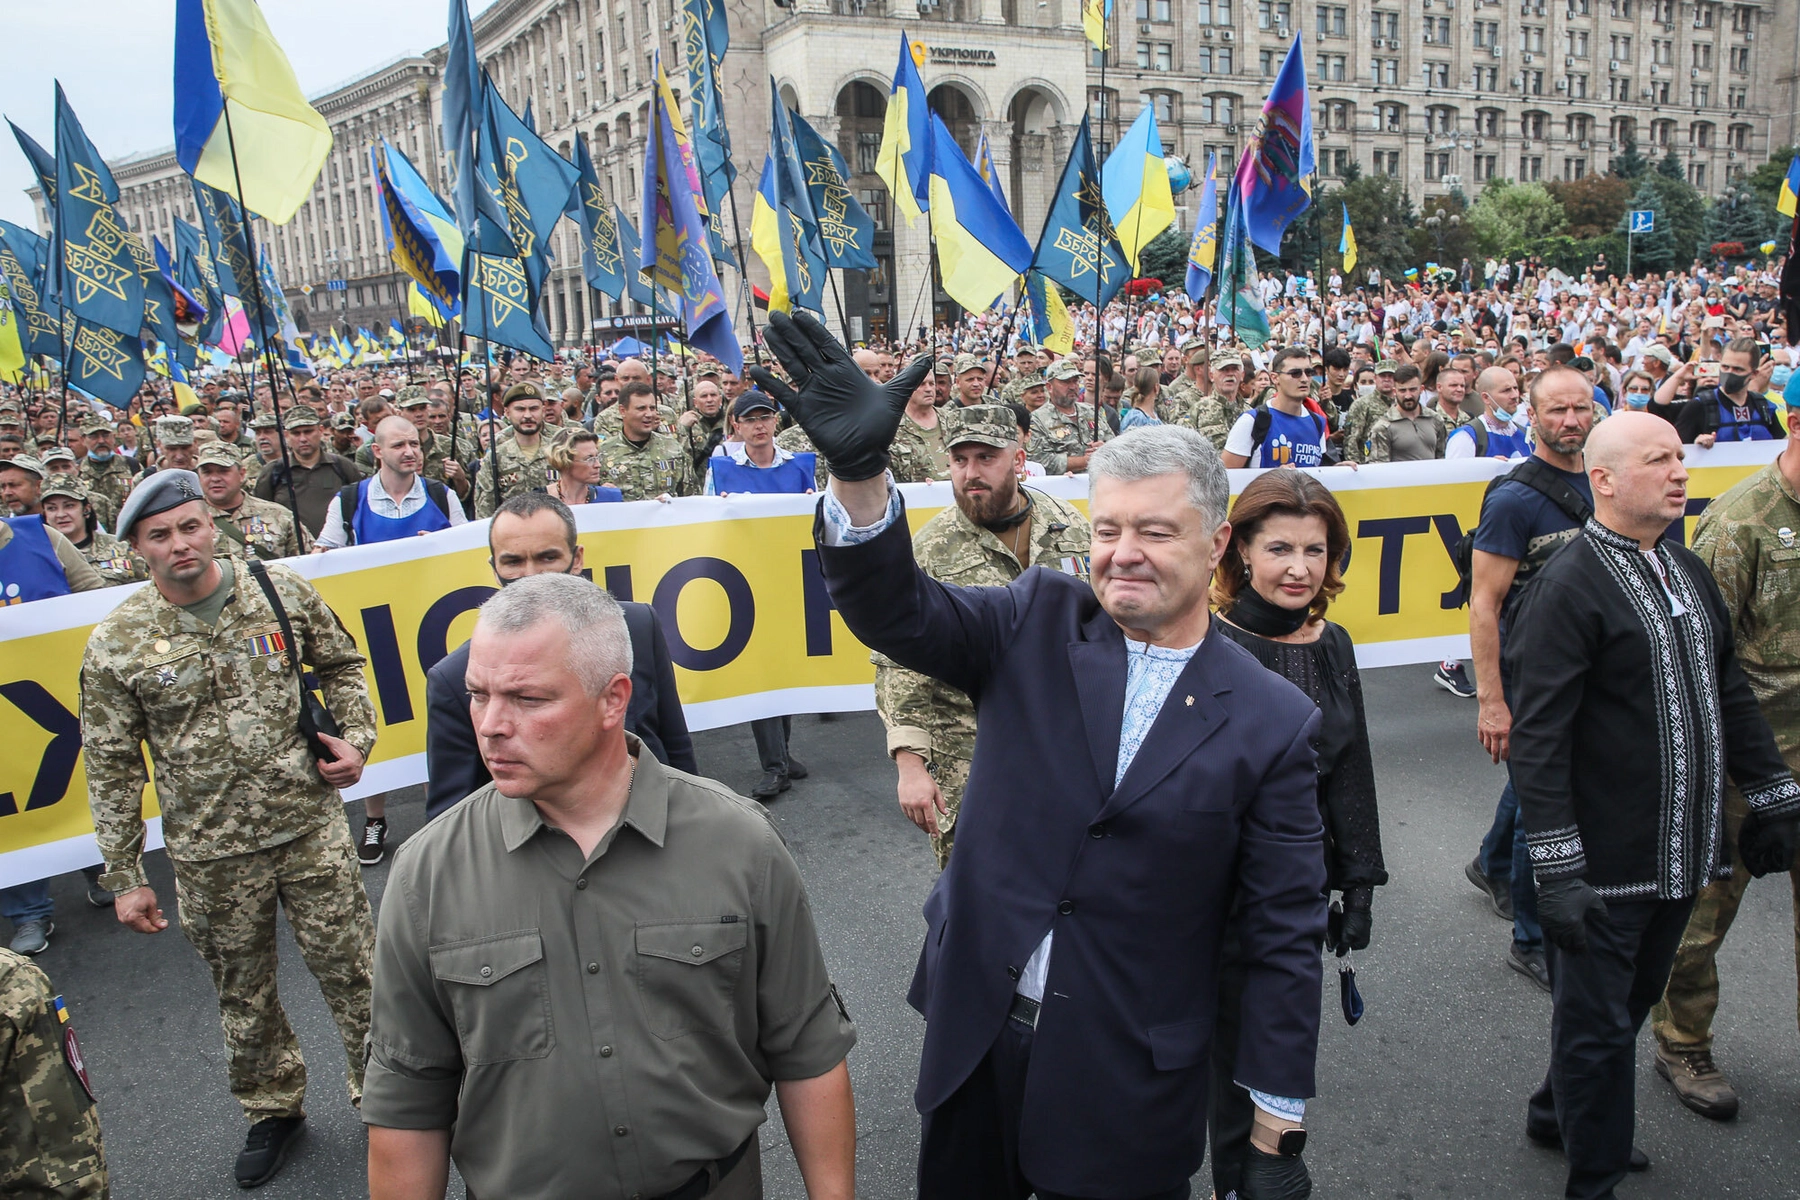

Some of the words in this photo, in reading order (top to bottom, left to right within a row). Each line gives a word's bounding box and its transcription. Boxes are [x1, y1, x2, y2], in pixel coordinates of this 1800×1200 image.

[929, 46, 996, 60] УКРПОШТА
[816, 166, 846, 186] БРАТ
[828, 200, 841, 212] ПО
[95, 226, 116, 244] ПО
[599, 224, 612, 237] ПО
[821, 222, 849, 240] БРОЇ
[65, 249, 116, 284] ЗБРОЇ
[624, 317, 653, 326] AROMA
[655, 315, 676, 324] KAVA
[78, 332, 118, 366] ЗБРОЇ
